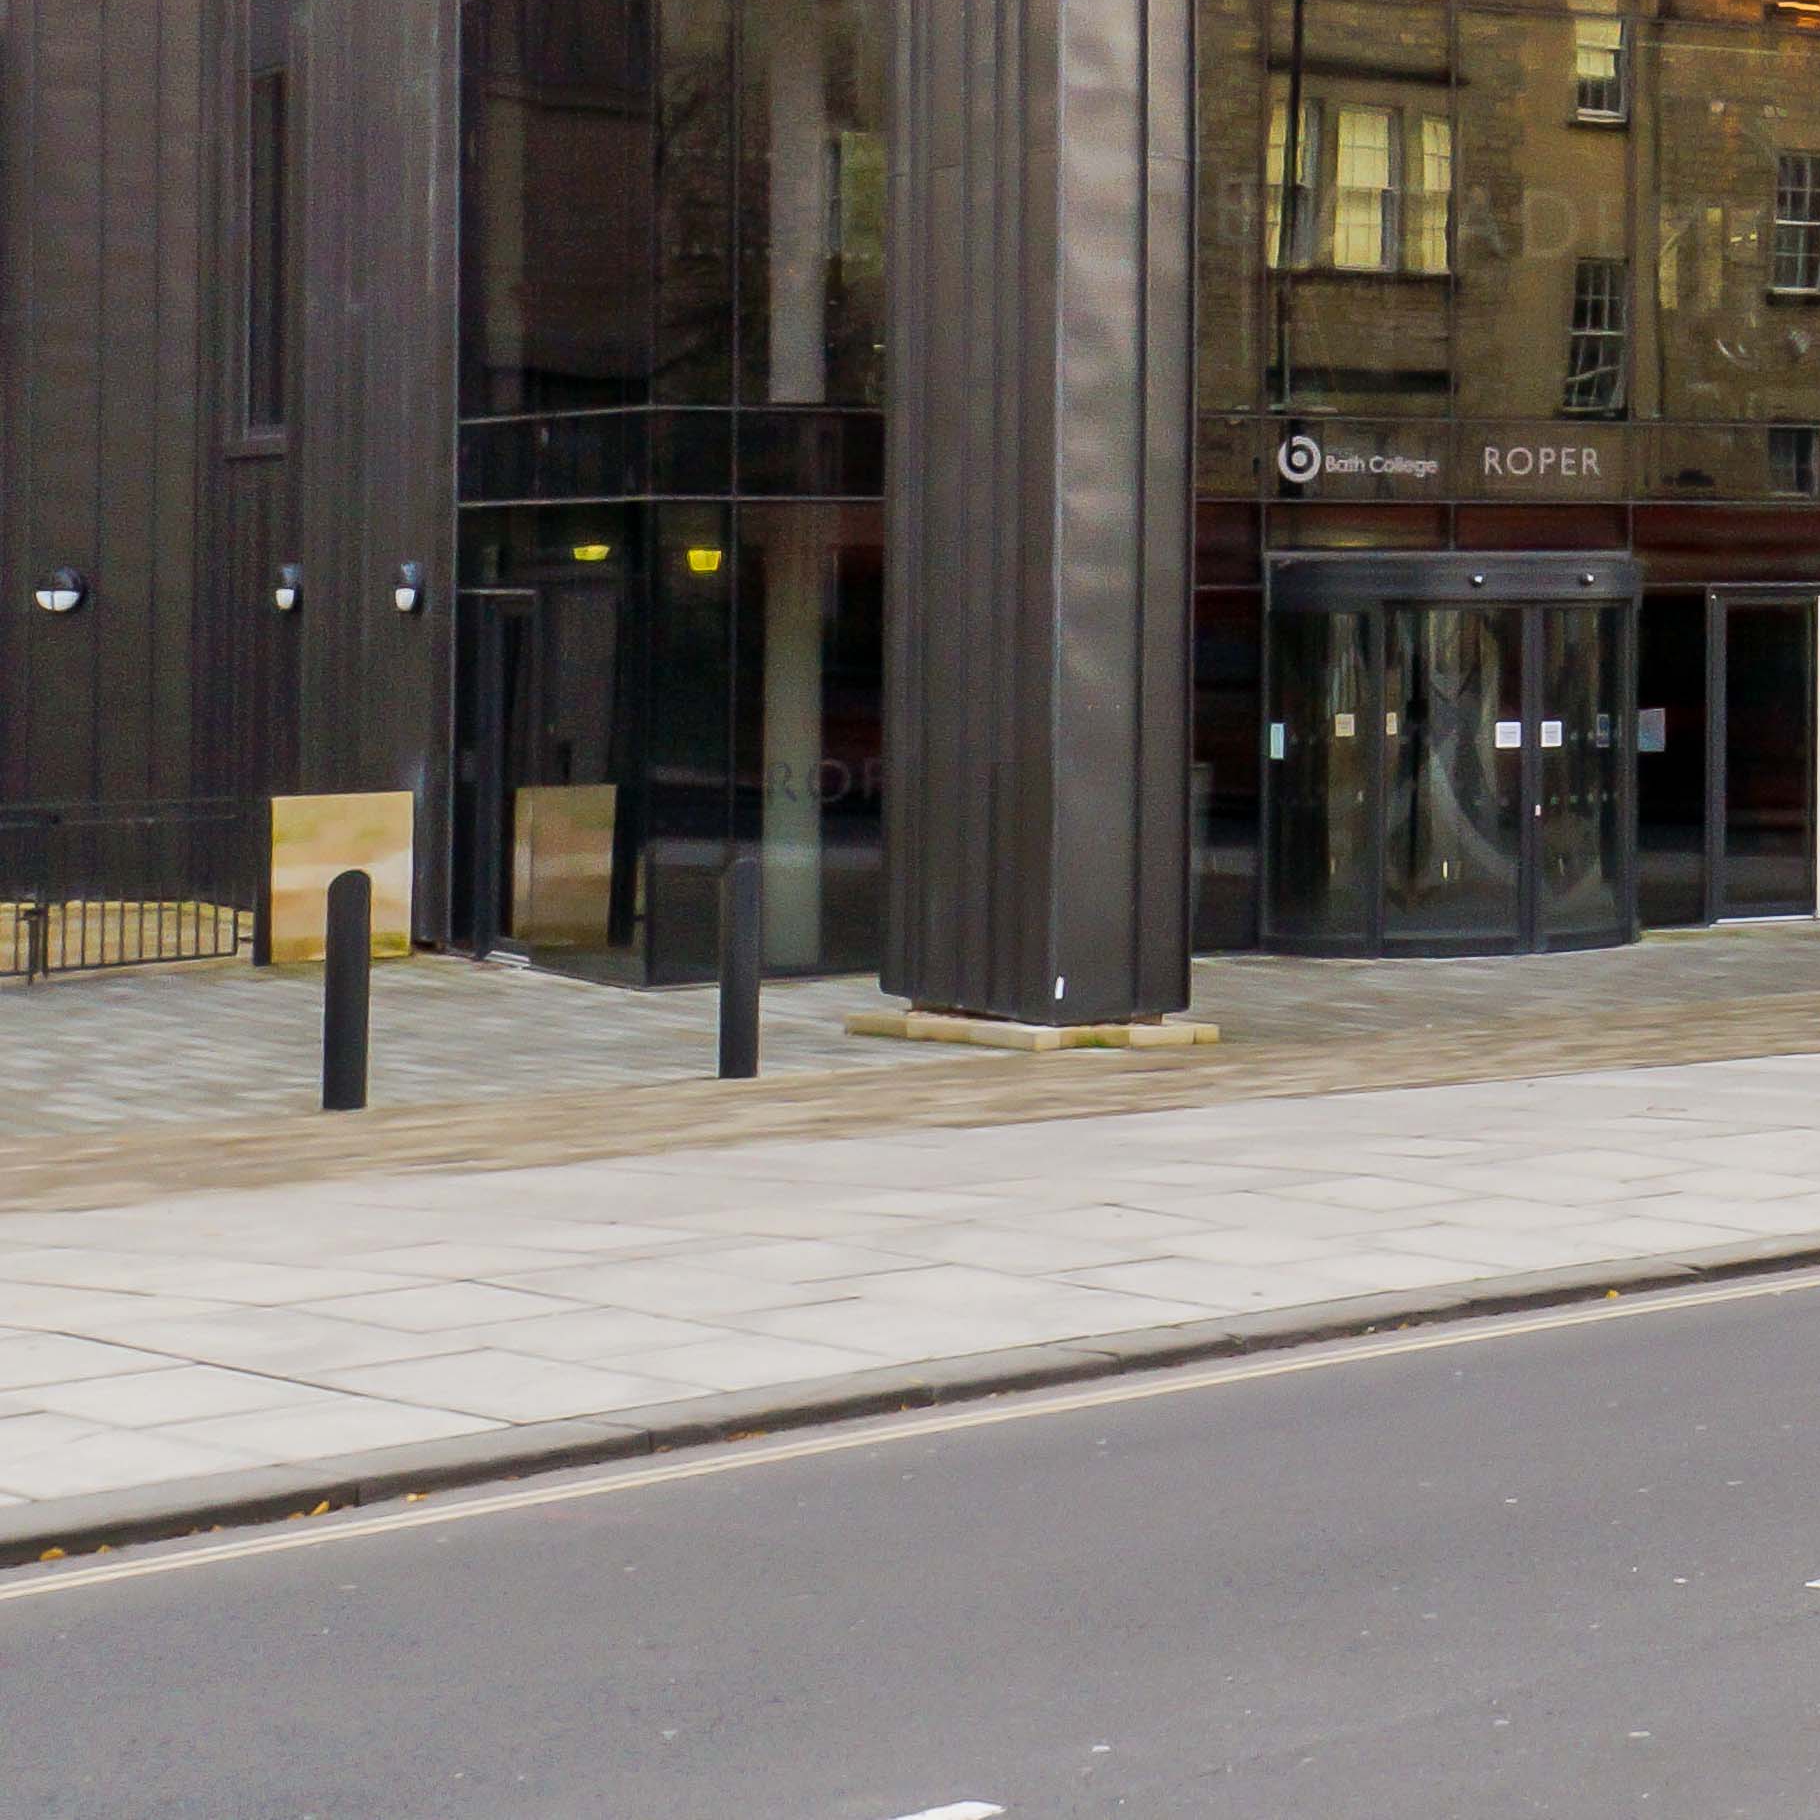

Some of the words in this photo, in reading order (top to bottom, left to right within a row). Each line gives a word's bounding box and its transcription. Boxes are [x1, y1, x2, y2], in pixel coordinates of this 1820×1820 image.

[1325, 453, 1366, 474] Bath
[1369, 454, 1439, 478] College
[1484, 446, 1601, 476] ROPER
